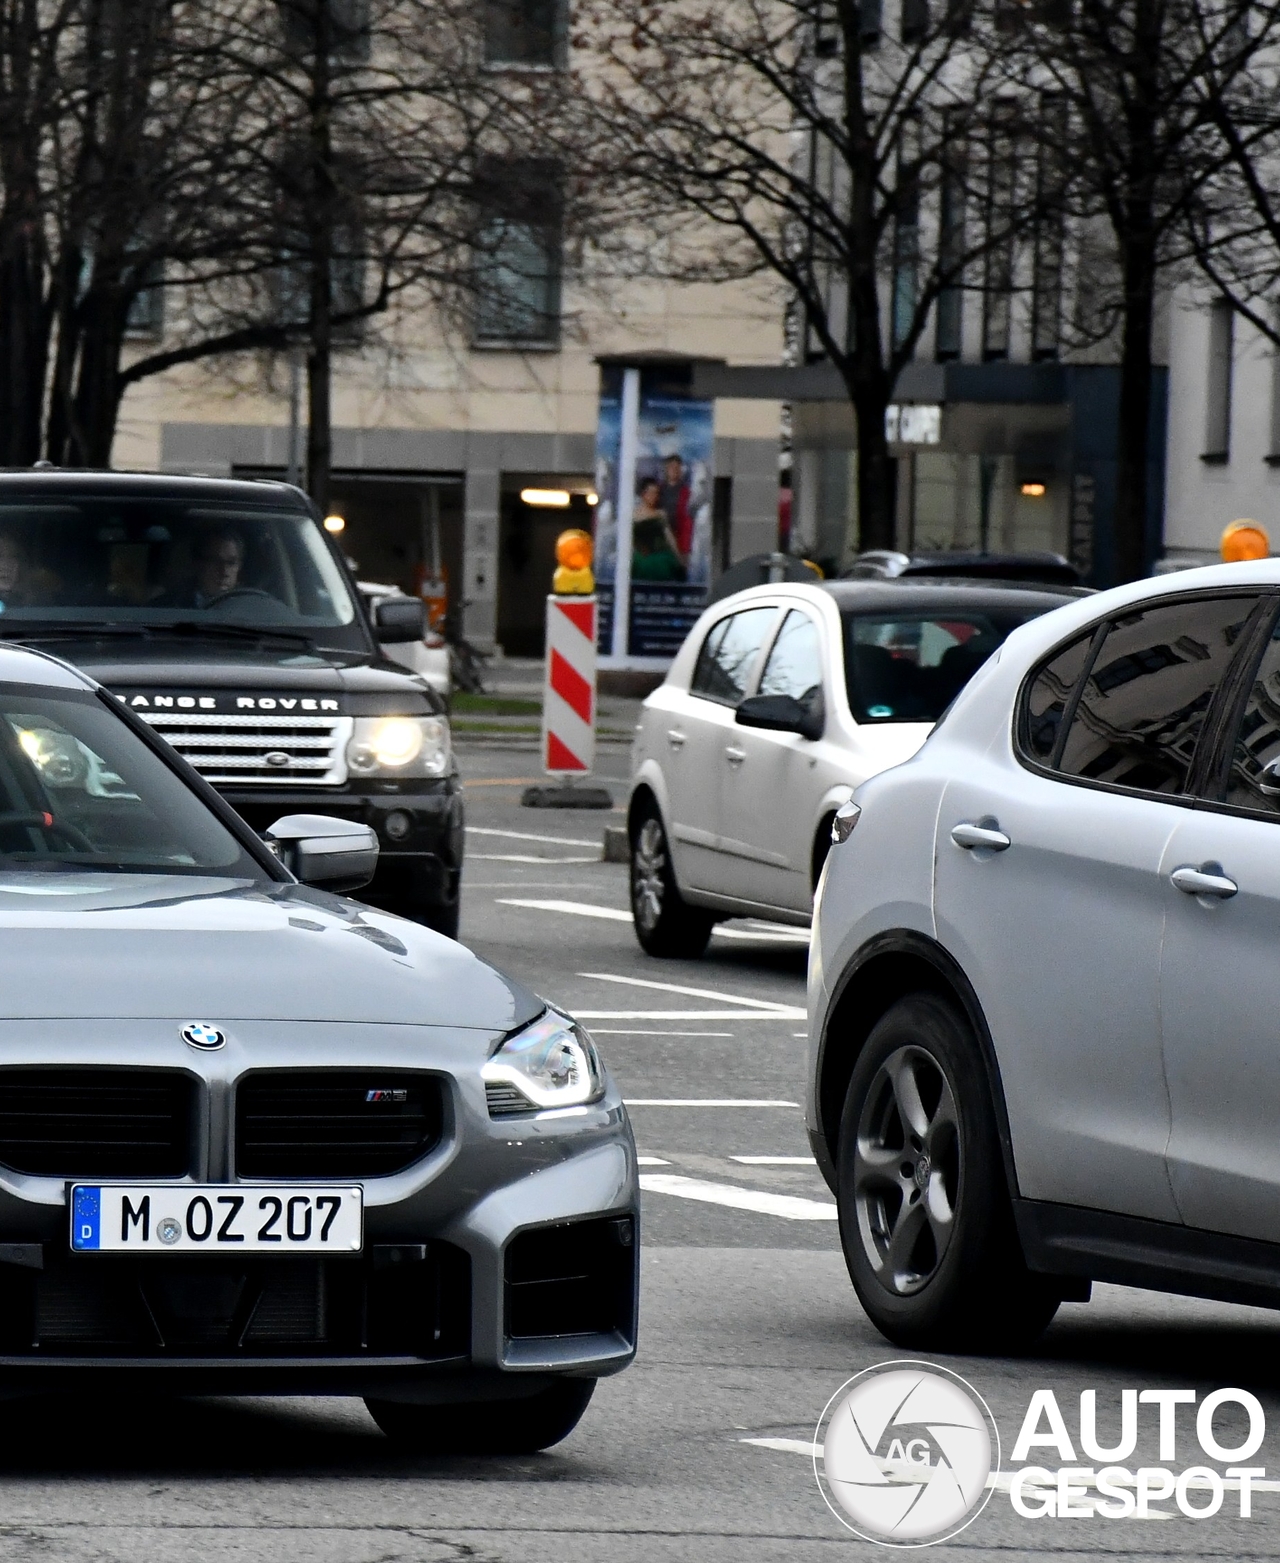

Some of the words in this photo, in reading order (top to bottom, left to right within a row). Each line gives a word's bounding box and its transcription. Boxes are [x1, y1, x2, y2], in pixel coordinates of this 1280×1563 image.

[236, 697, 340, 711] ROVER
[121, 1195, 151, 1242] M
[186, 1195, 245, 1242] OZ
[257, 1195, 342, 1242] 207
[81, 1225, 93, 1239] D
